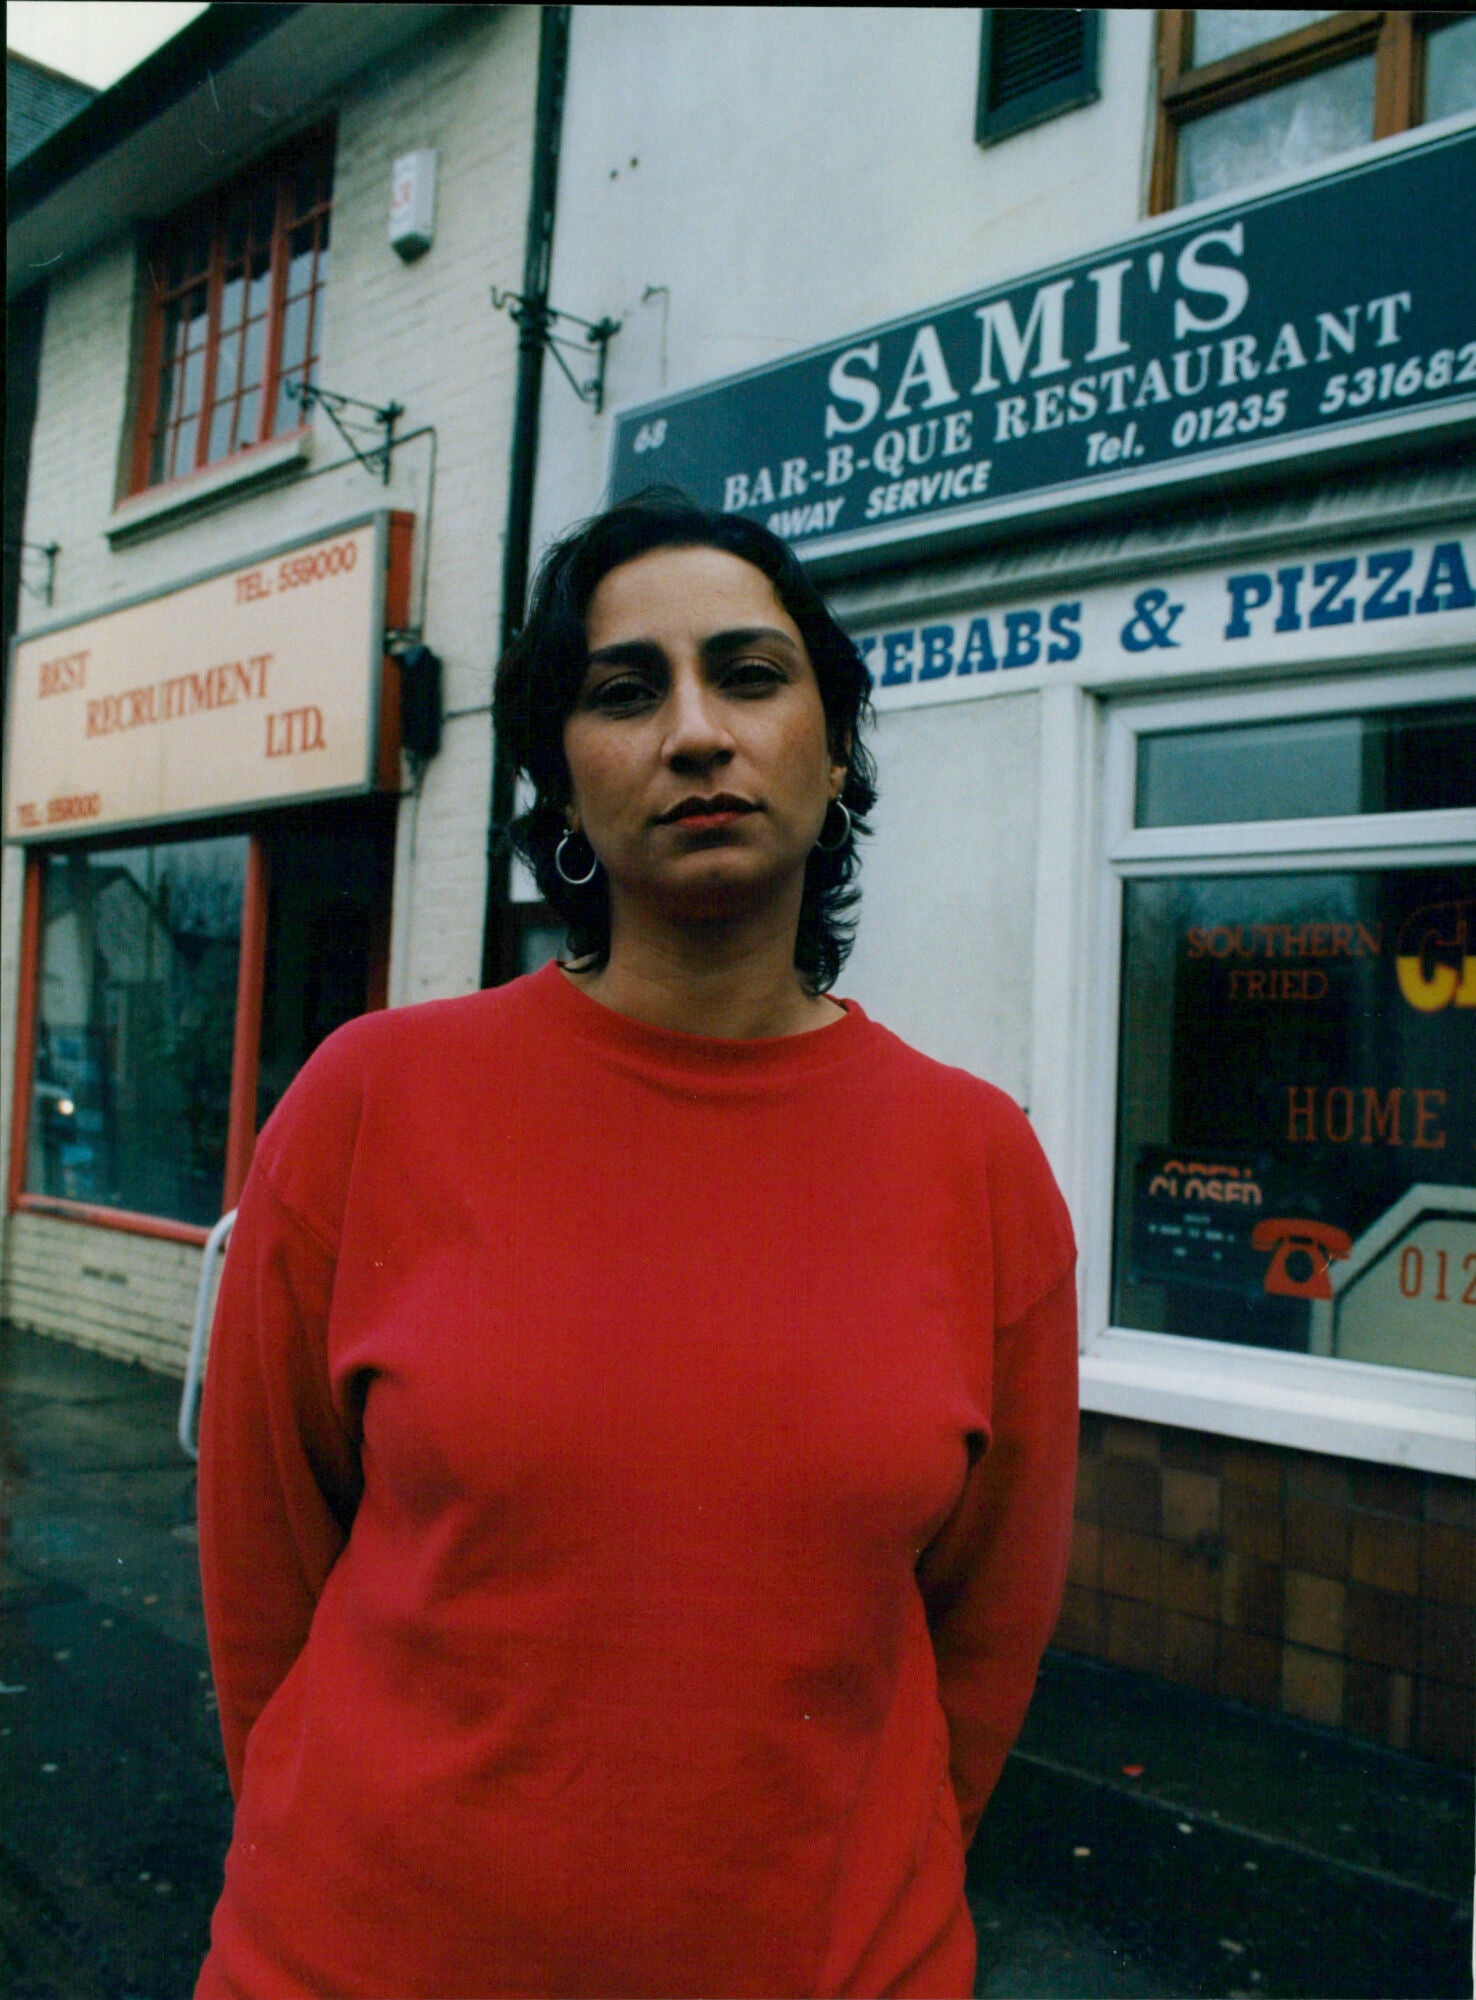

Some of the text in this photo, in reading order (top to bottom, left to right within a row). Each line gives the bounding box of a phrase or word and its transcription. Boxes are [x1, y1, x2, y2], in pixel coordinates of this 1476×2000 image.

[825, 222, 1249, 440] SAMI'S
[723, 290, 1412, 512] BAR-B-QUE RESTAURANT
[1086, 341, 1476, 467] Tel. 01235 531682
[633, 420, 668, 454] 68
[864, 460, 993, 520] SERVICE
[1120, 588, 1186, 653] &
[1224, 541, 1476, 640] PIZZA
[85, 653, 273, 739] RECRUITMENT
[1186, 922, 1382, 959] SOUTHERN
[1228, 969, 1329, 1000] FRIED
[1286, 1086, 1448, 1150] HOME
[1400, 1245, 1476, 1306] 012
